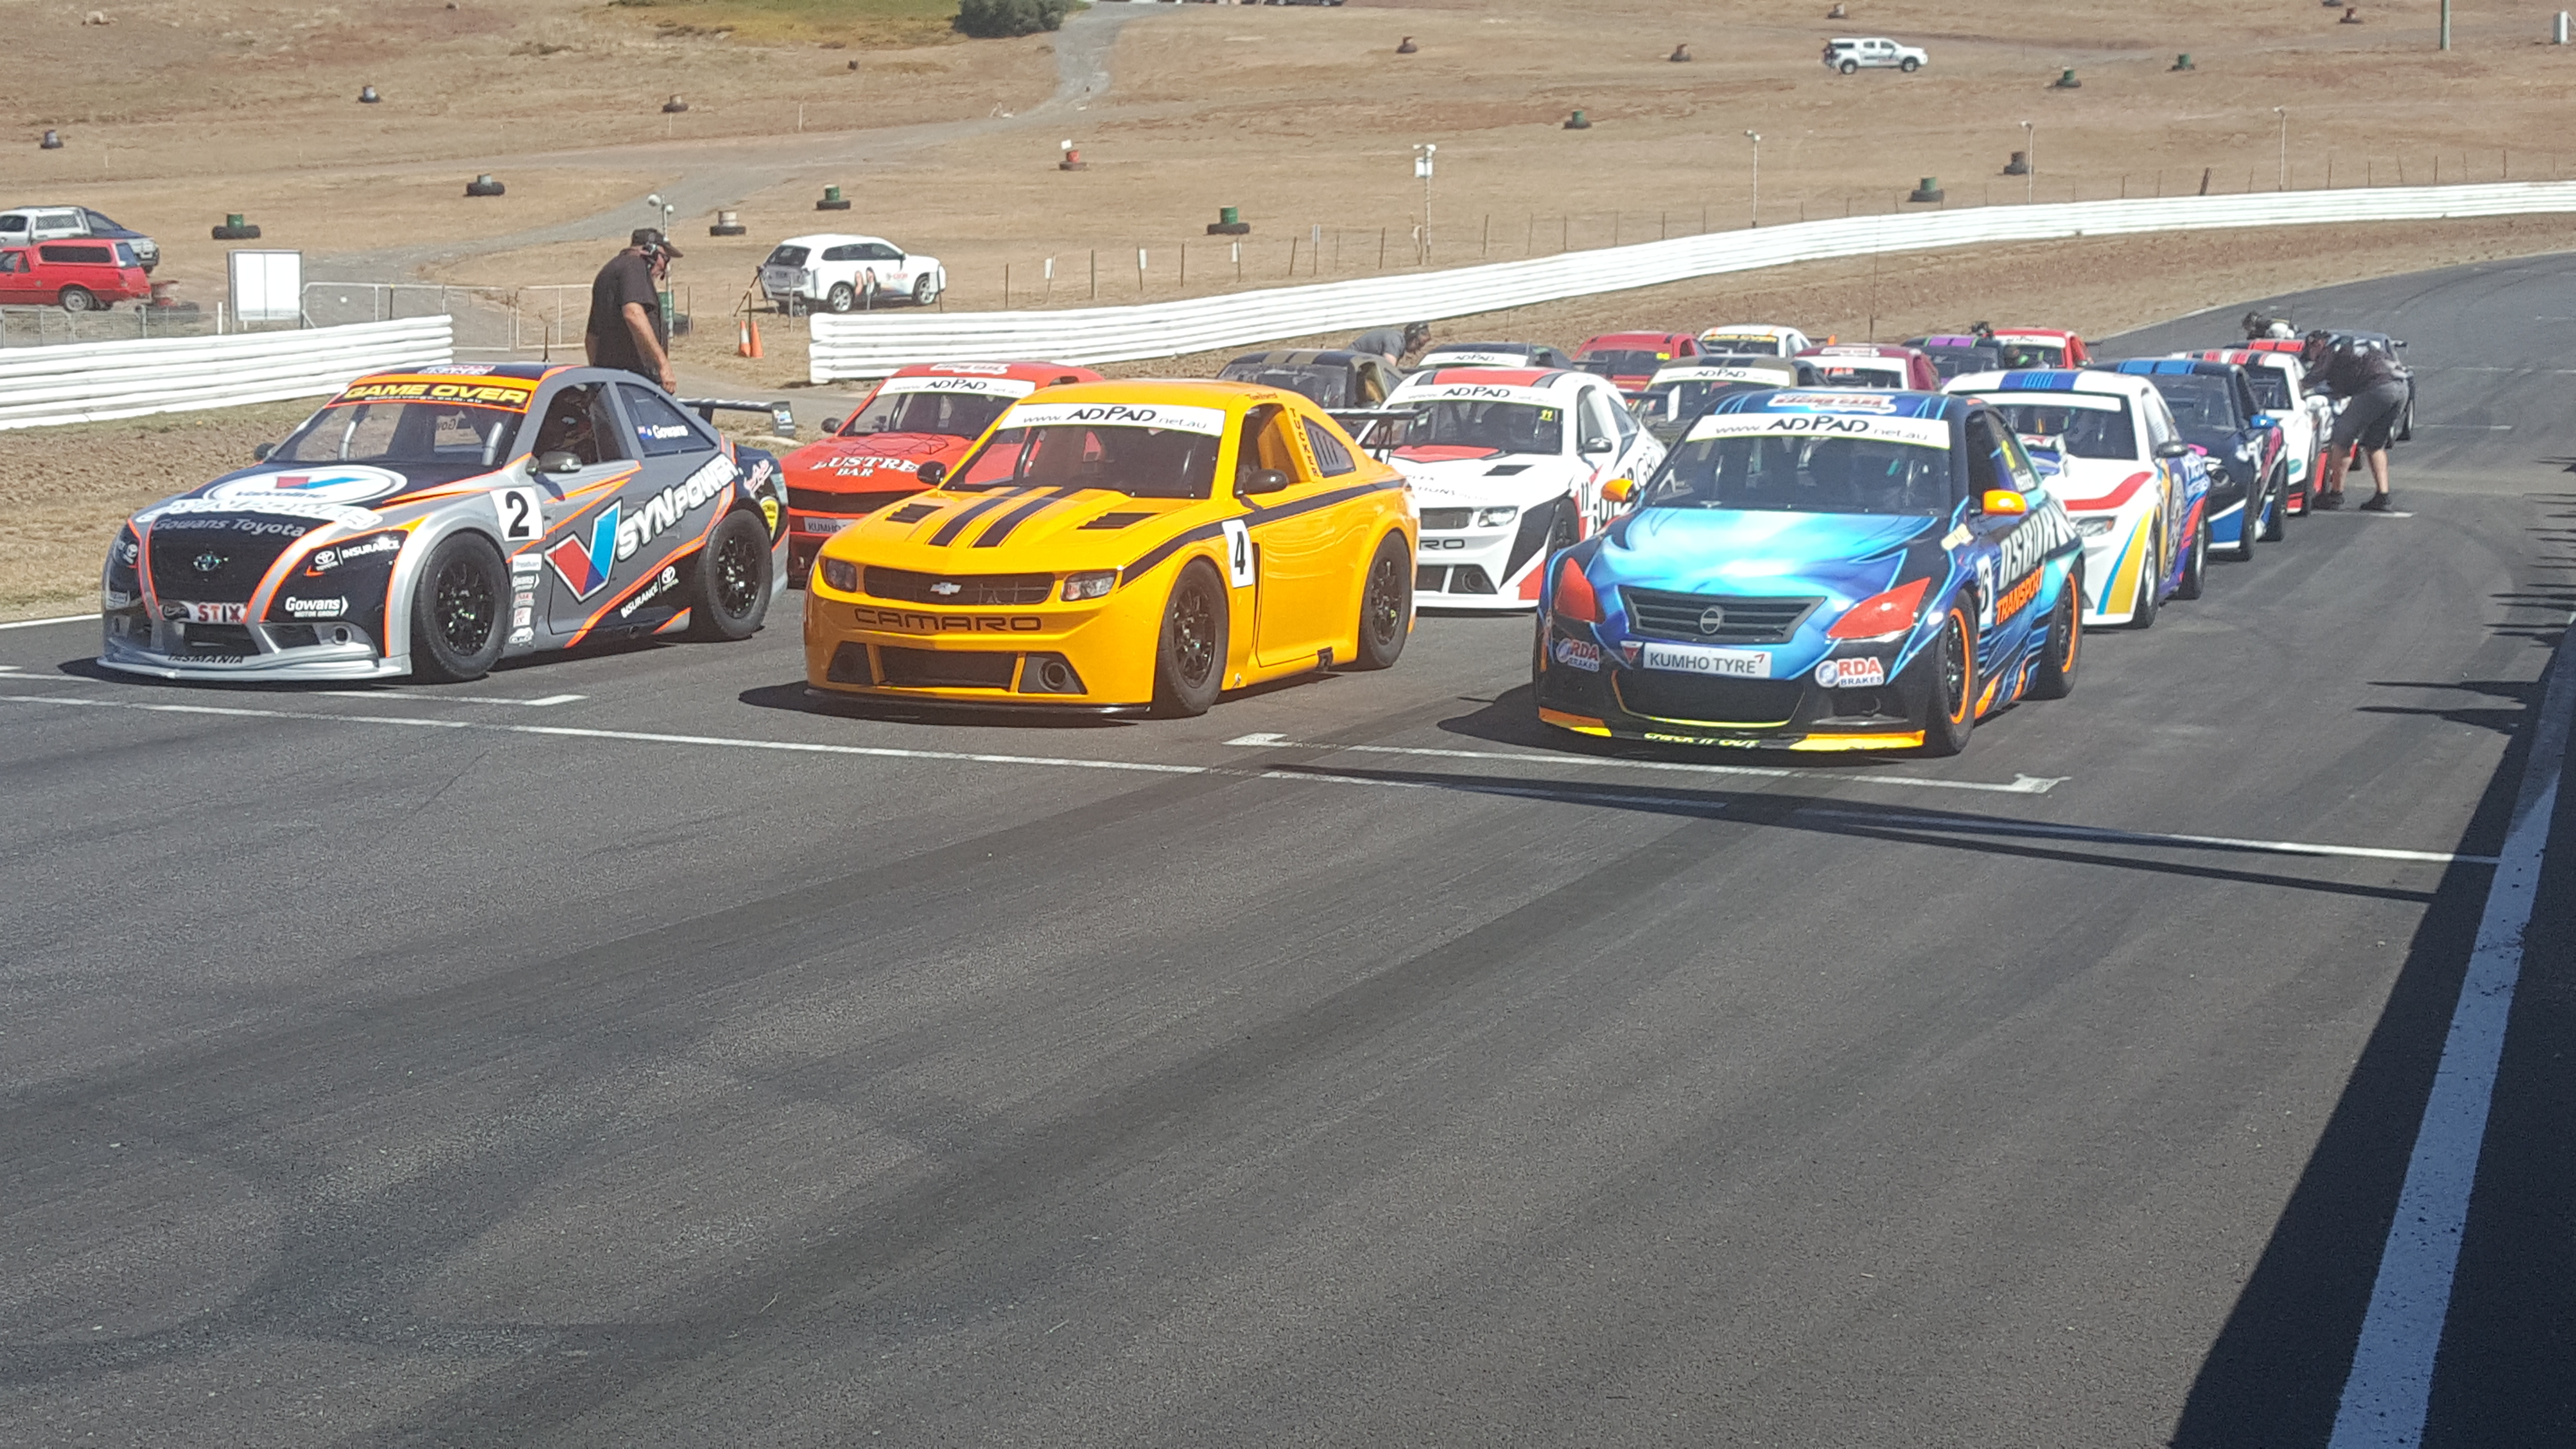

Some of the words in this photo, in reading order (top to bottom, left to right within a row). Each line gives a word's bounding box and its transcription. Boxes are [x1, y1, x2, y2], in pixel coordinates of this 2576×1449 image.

[343, 384, 430, 399] GAME
[431, 385, 529, 403] OVER
[1066, 406, 1157, 422] ADPAD
[653, 424, 689, 439] Gowans
[1767, 416, 1869, 432] ADPAD
[809, 456, 920, 473] LUSTRE
[835, 467, 874, 477] BAR
[505, 490, 530, 538] 2
[617, 452, 739, 561] SYNPOWER
[153, 518, 226, 531] Gowans
[232, 518, 306, 537] Toyota
[341, 536, 401, 559] INSURANCE
[1234, 531, 1246, 575] 4
[285, 596, 341, 612] Gowans
[620, 582, 660, 618] INSURANCE
[1996, 565, 2044, 626] TRANSPORT
[198, 604, 242, 623] STIX
[854, 608, 1042, 631] CAMARO
[167, 655, 244, 664] TASMANIA
[1570, 641, 1598, 661] RDA
[1649, 652, 1710, 671] KUMHO
[1714, 657, 1756, 674] TYRE
[1839, 660, 1882, 676] RDA
[1840, 676, 1883, 686] BRAKES
